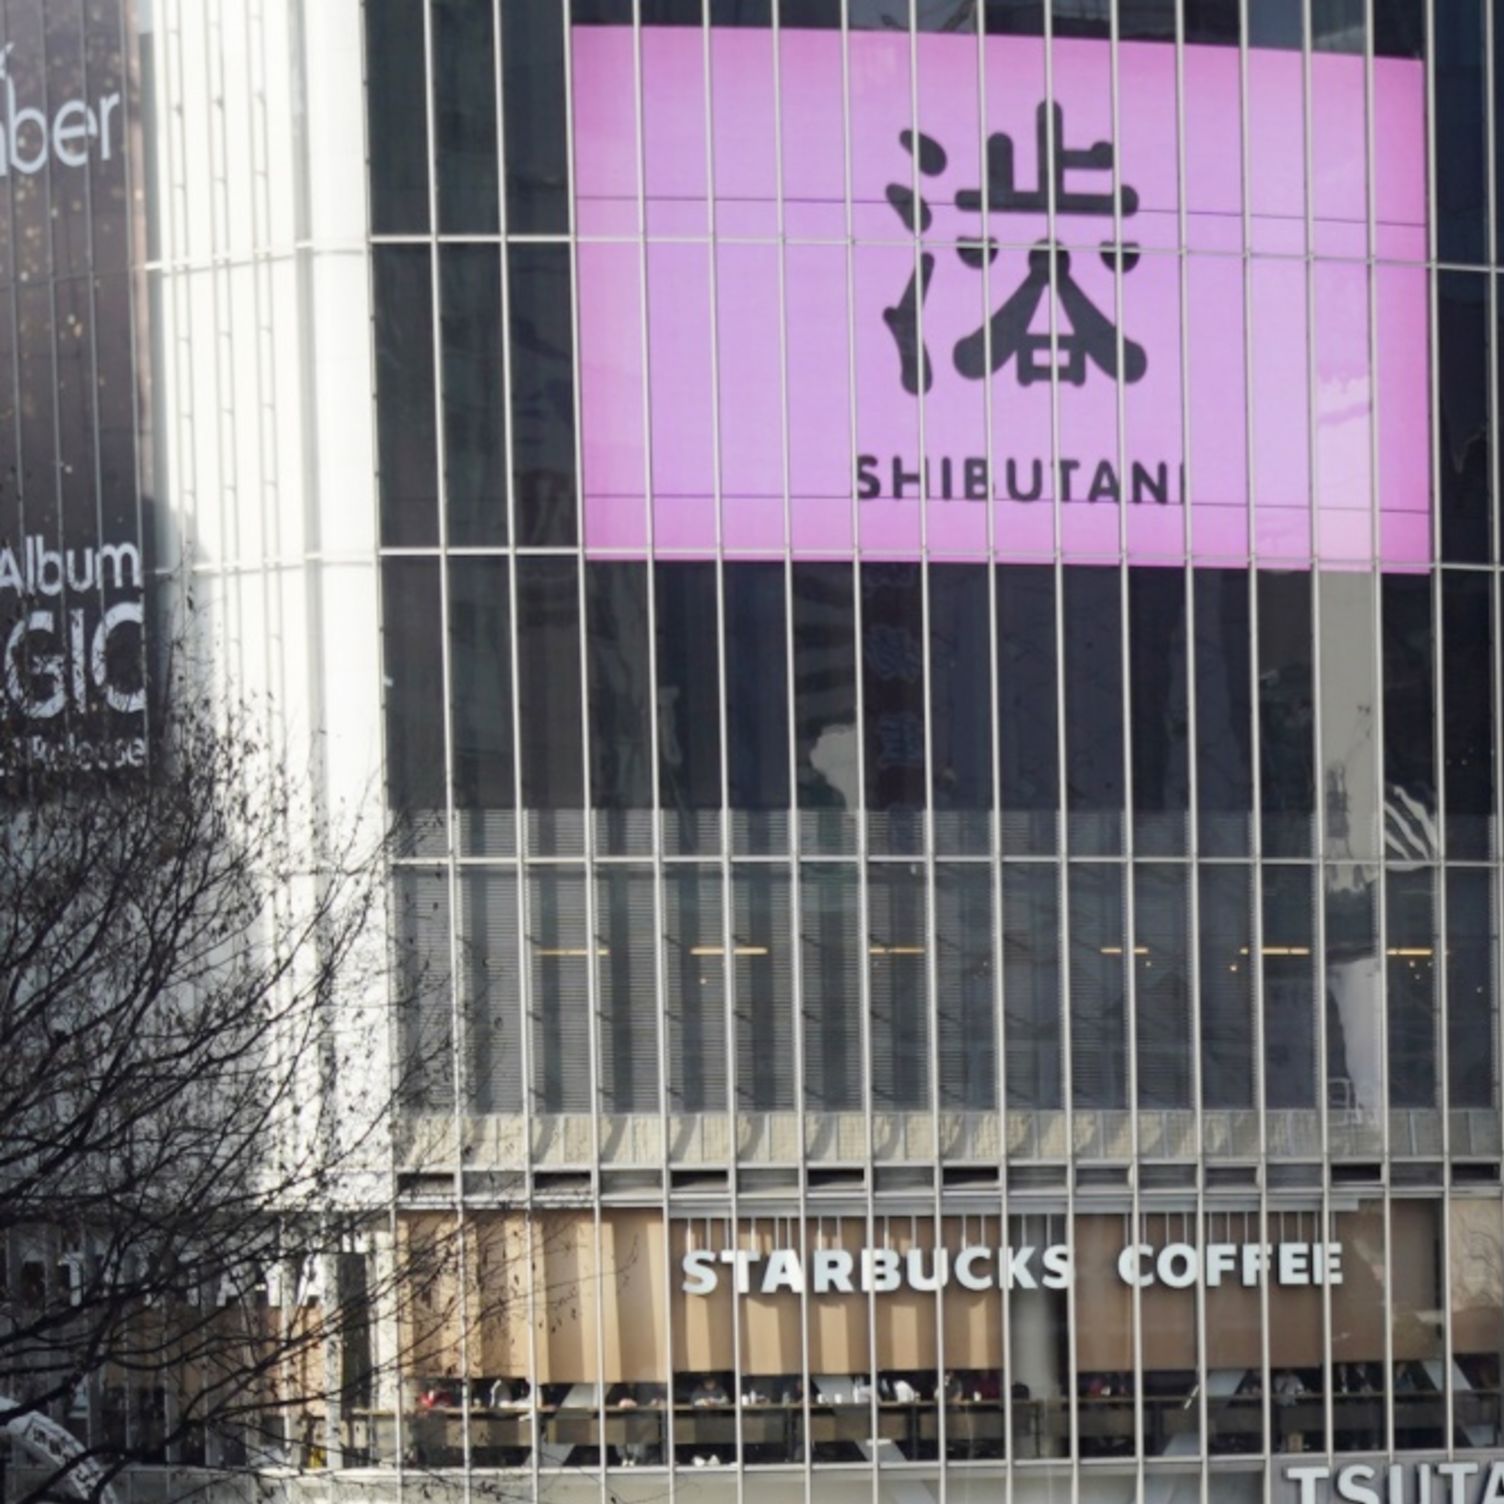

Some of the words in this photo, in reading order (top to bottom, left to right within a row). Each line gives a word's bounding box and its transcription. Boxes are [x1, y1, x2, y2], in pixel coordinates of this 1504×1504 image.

[0, 74, 120, 176] ber
[857, 455, 1191, 504] SHIBUTANI
[0, 534, 142, 596] Album
[0, 603, 147, 718] GIC
[682, 1243, 1074, 1295] STARBUCKS
[1117, 1241, 1344, 1288] COFFEE
